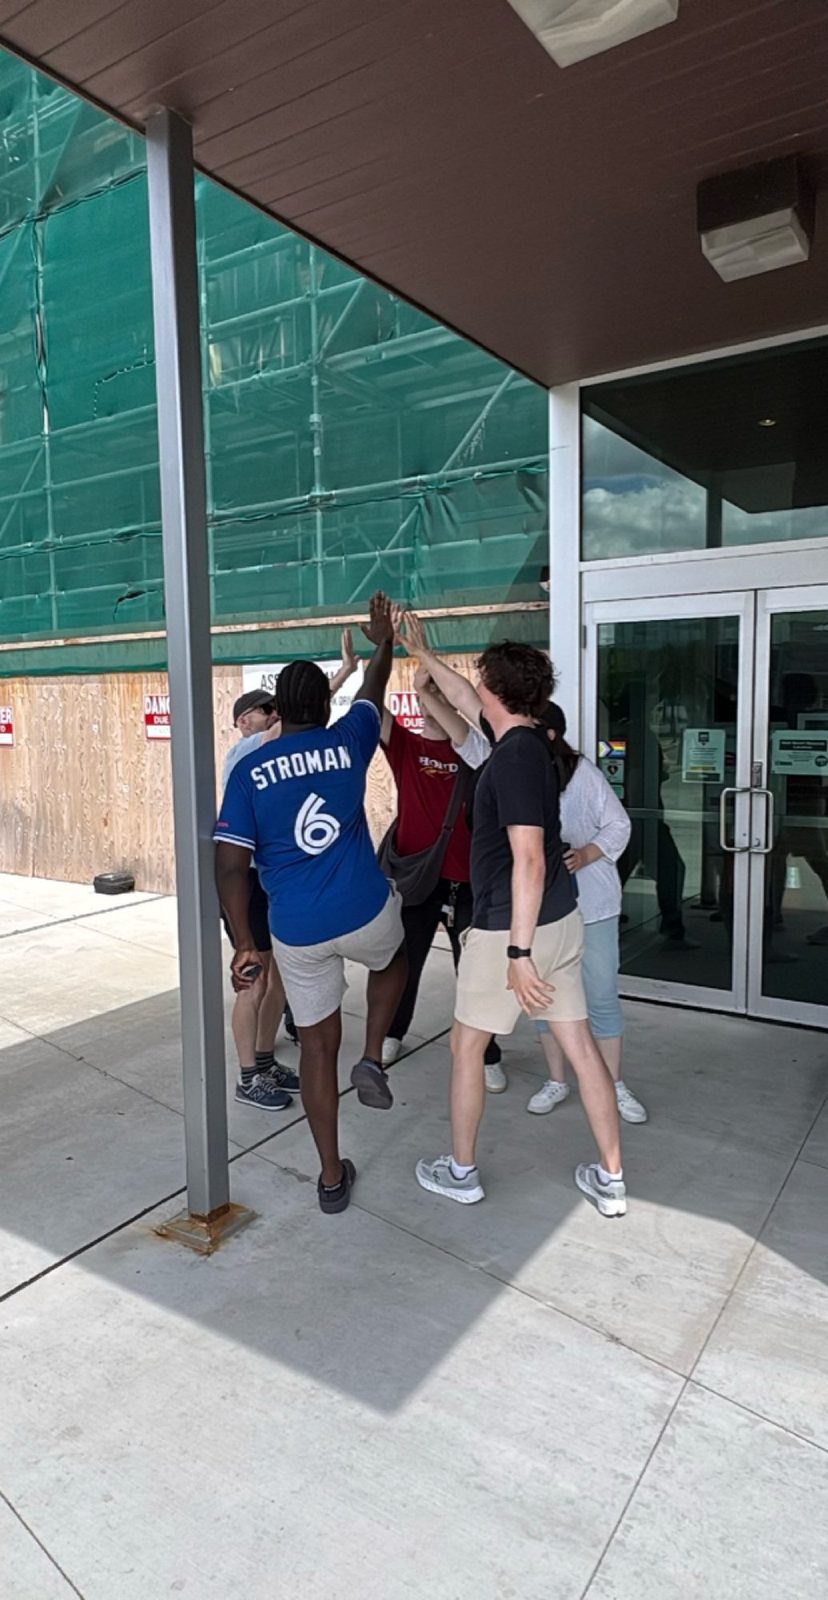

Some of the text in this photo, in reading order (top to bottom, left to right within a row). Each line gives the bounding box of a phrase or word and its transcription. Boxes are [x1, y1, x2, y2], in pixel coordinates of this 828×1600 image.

[403, 718, 424, 727] DUE
[250, 745, 352, 790] STROMAN
[294, 792, 341, 856] 6
